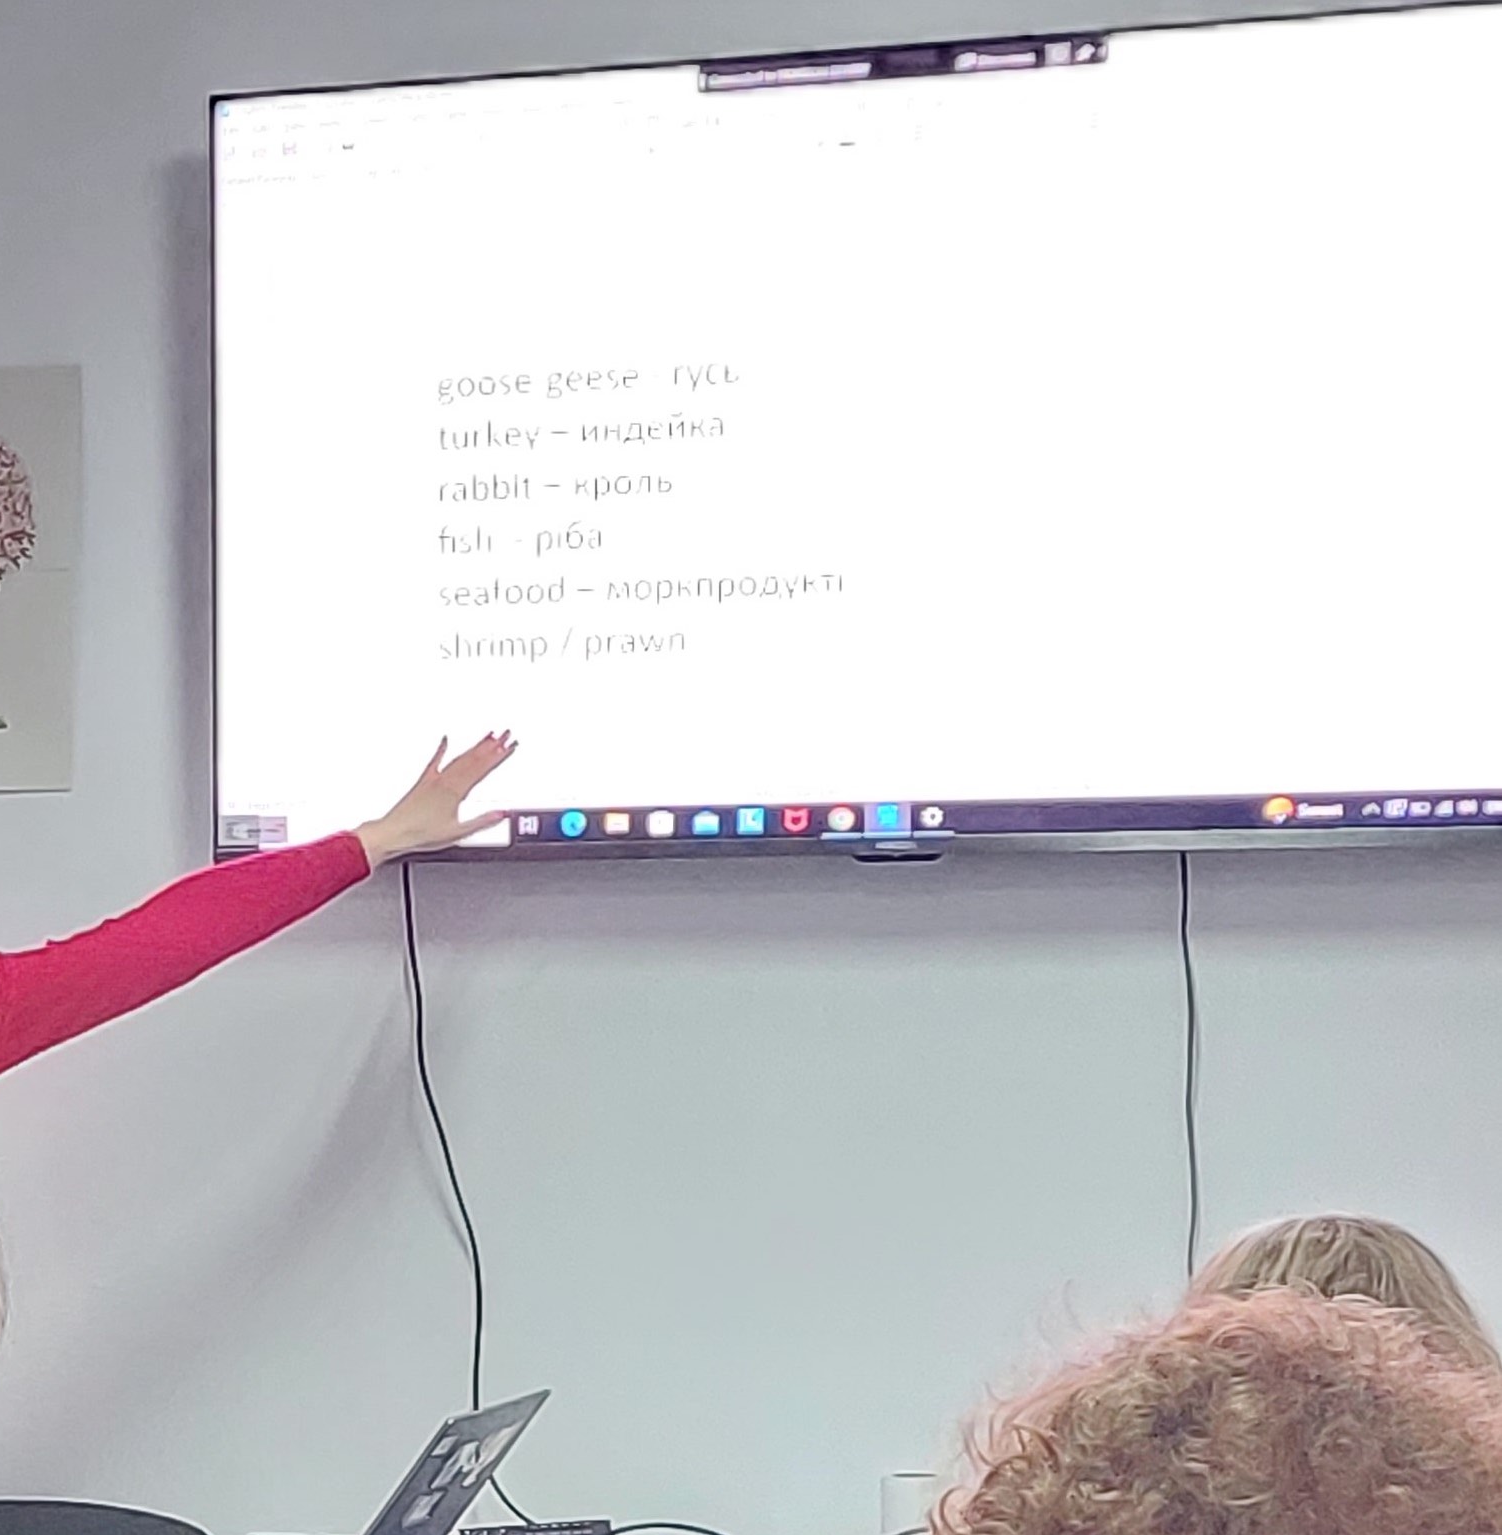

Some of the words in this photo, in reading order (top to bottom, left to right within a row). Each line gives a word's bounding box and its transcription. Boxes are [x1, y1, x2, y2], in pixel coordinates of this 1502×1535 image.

[437, 373, 533, 406] goose
[546, 368, 640, 400] geese
[438, 419, 542, 451] turkey
[581, 411, 725, 445] индейка
[438, 472, 532, 503] rabbit
[574, 474, 674, 502] кроль
[437, 524, 493, 555] fish
[438, 575, 566, 607] seafood
[439, 630, 549, 664] shrimp
[585, 631, 687, 662] prawn
